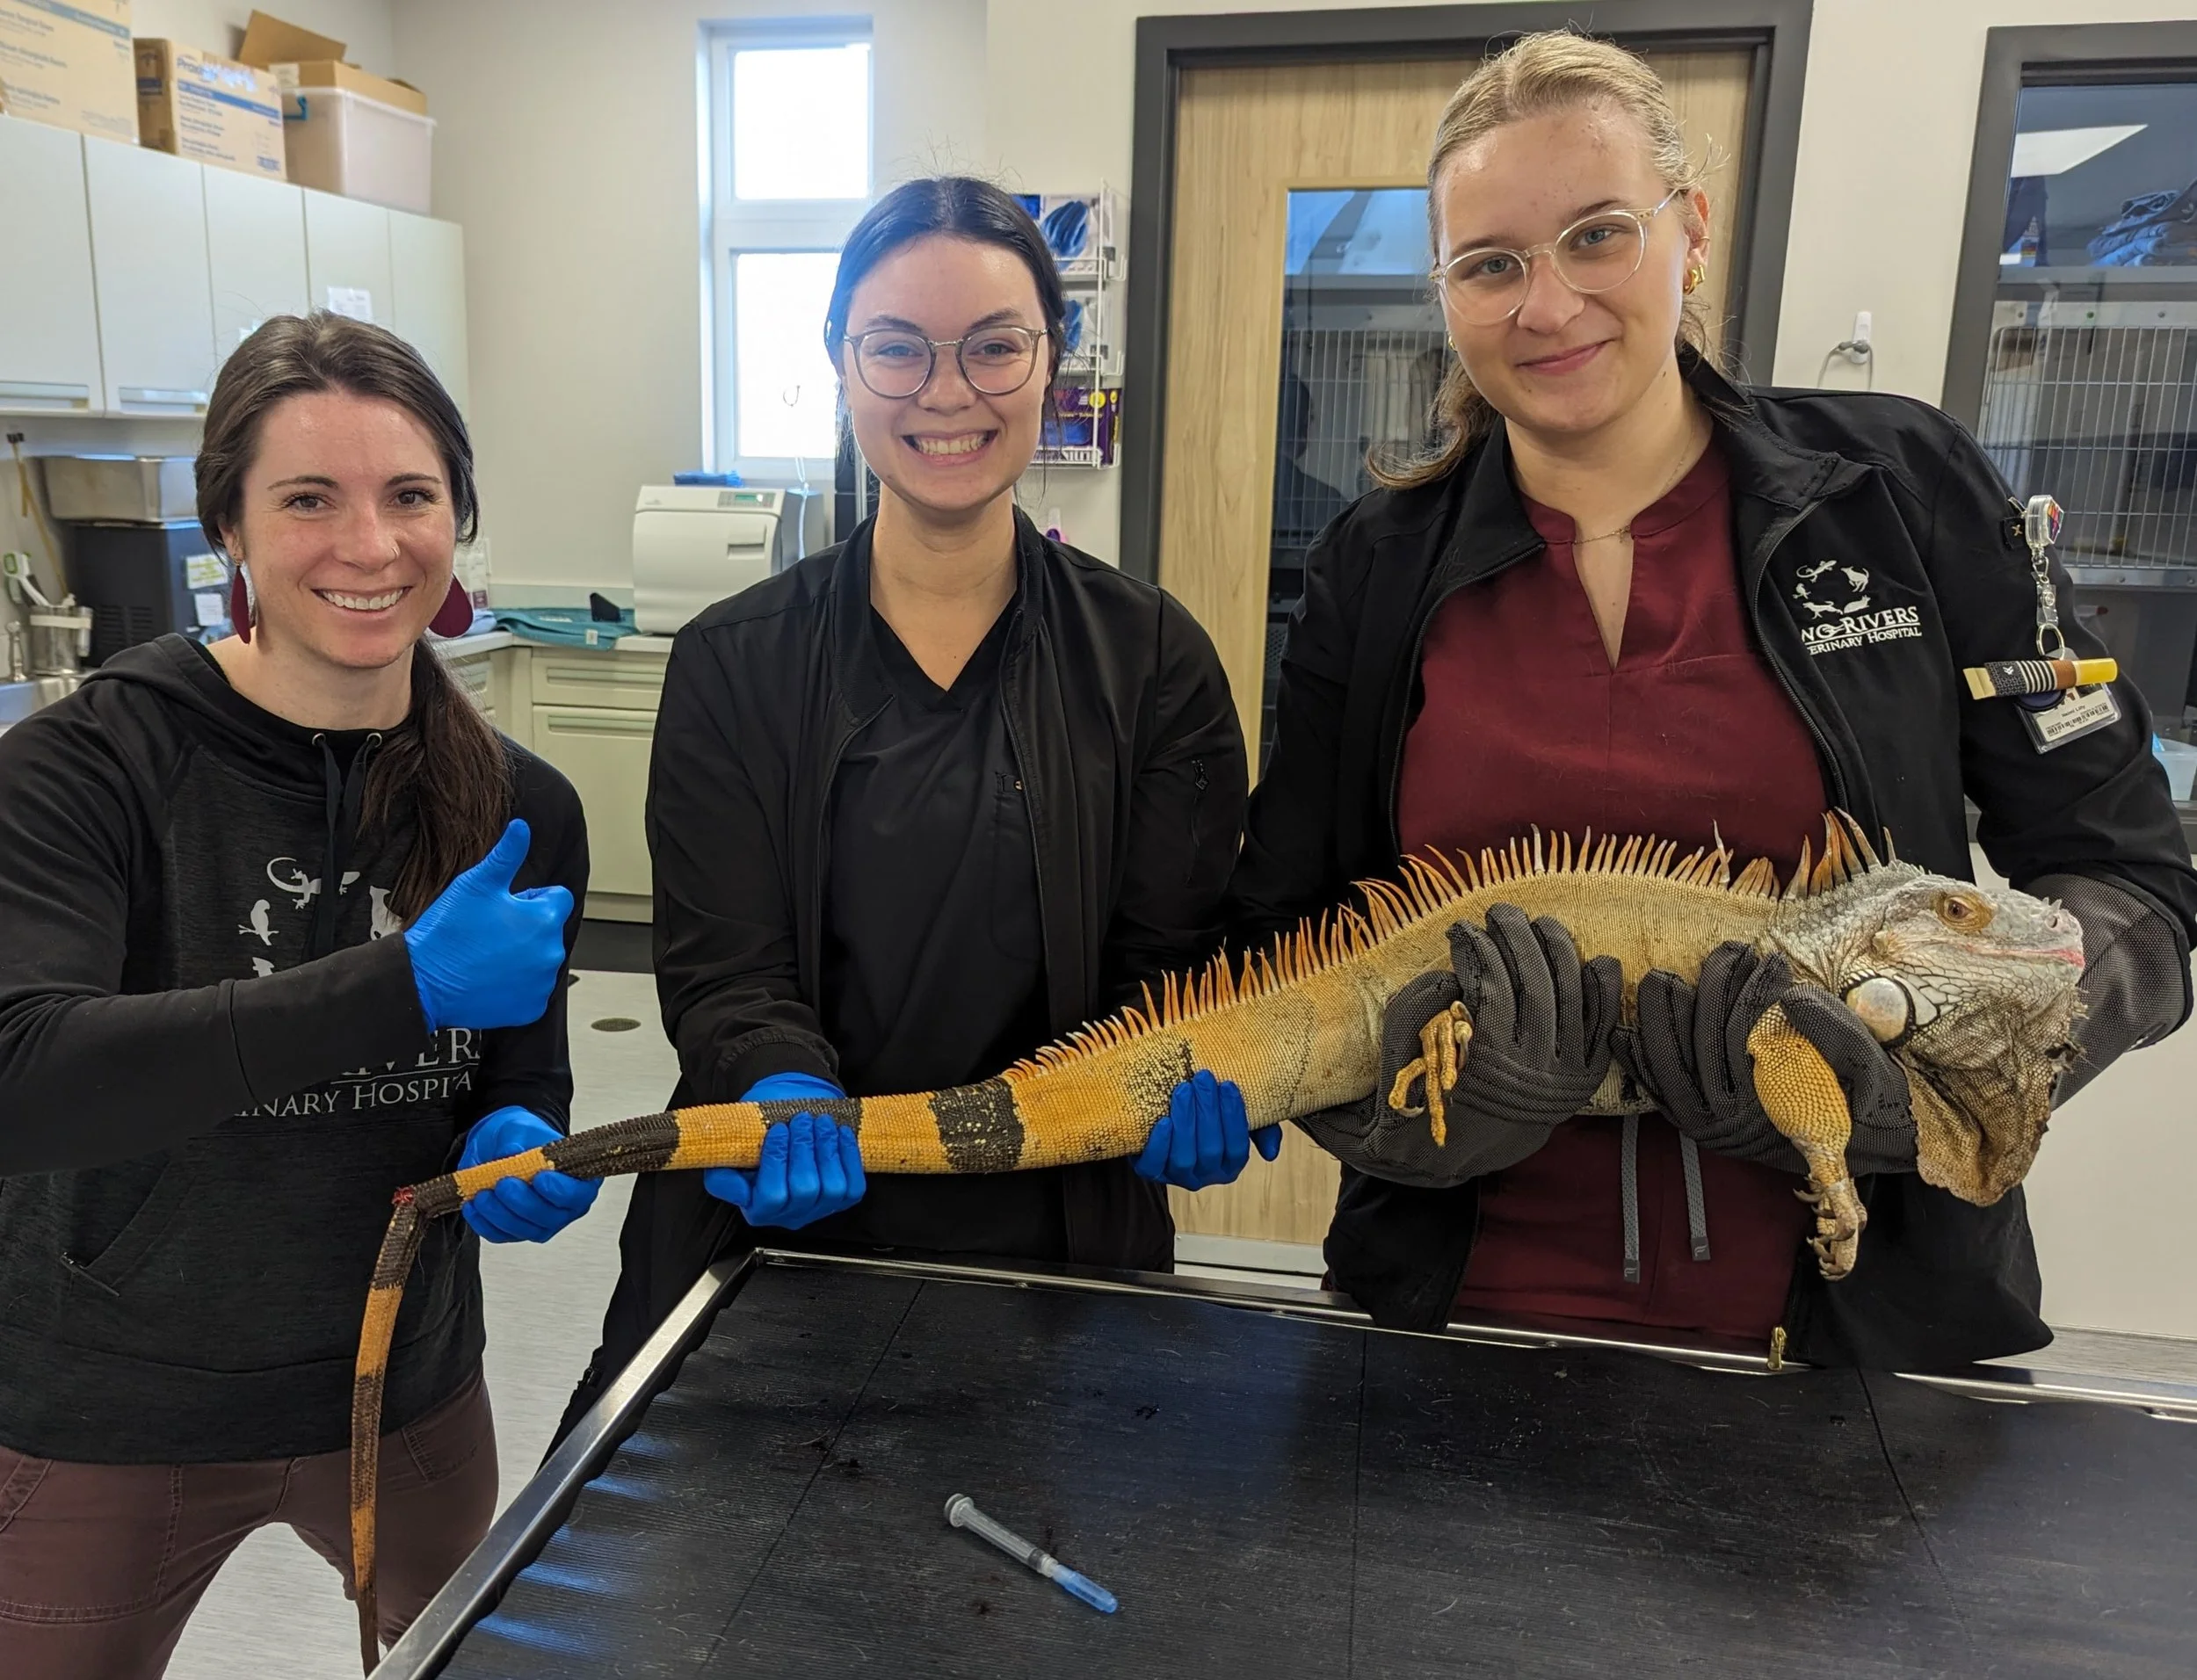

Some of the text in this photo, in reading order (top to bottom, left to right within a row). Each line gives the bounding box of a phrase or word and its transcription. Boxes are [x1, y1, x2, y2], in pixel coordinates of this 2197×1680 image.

[1840, 605, 1919, 634] RIVERS
[1807, 626, 1923, 655] ERINARY HOSPITAL
[352, 1070, 472, 1110] HOSPIA
